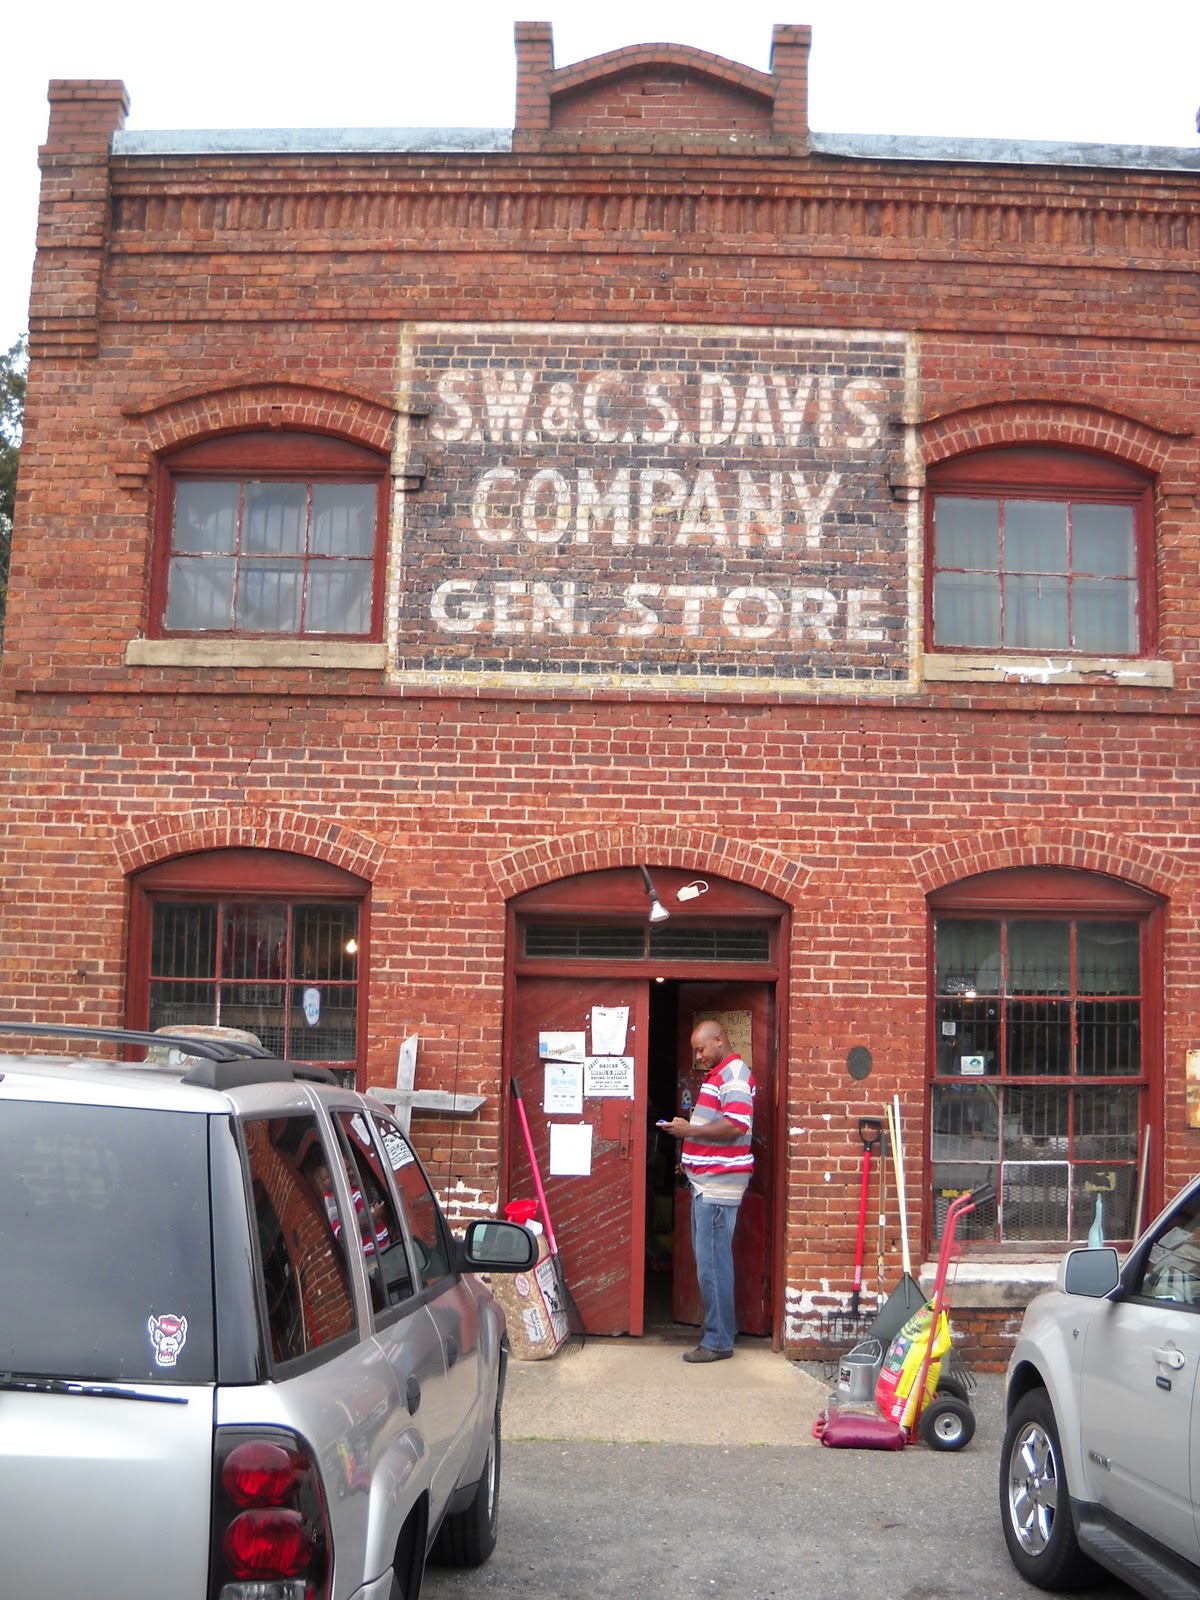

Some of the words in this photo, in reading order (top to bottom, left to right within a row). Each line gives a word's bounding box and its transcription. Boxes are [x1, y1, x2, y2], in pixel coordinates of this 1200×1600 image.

[700, 374, 881, 449] DAVIS
[472, 467, 840, 548] COMPANY
[618, 583, 886, 641] STORE
